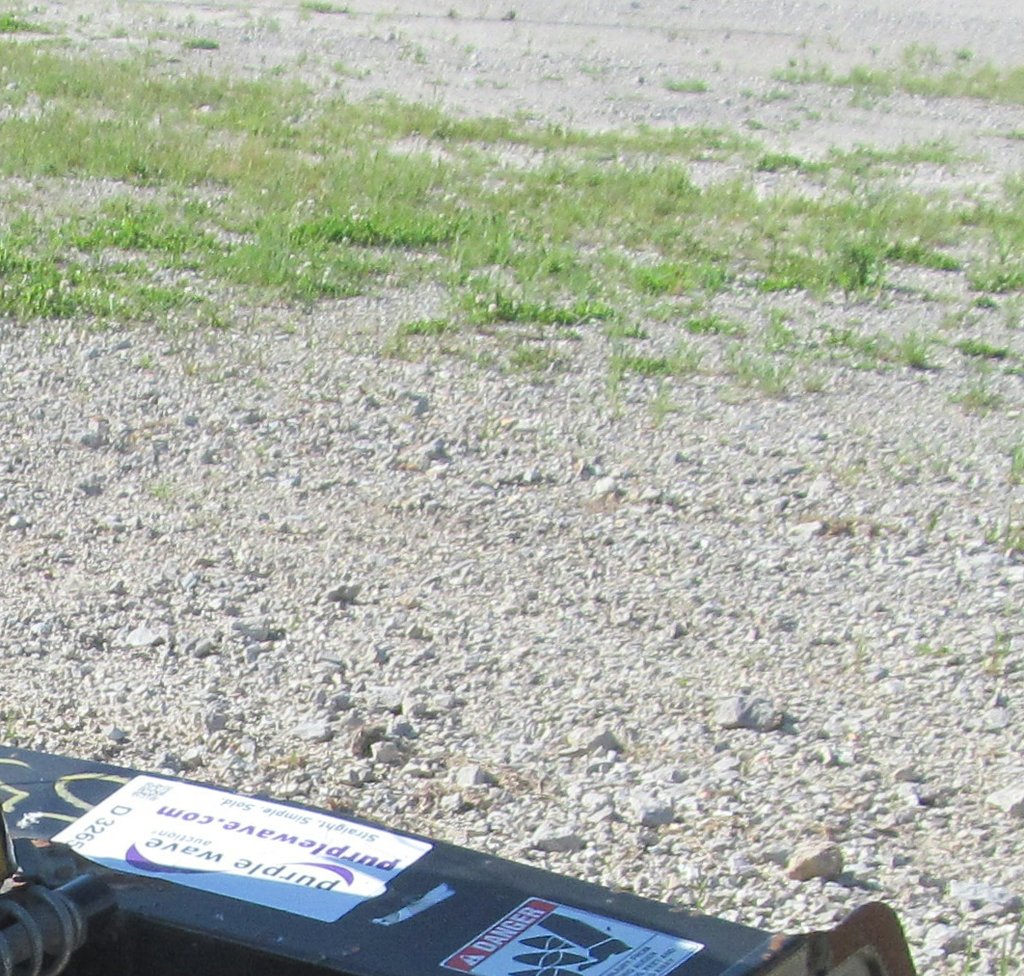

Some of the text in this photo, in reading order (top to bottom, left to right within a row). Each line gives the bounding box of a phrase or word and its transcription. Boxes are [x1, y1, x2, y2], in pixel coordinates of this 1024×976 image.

[110, 805, 132, 816] D
[318, 819, 380, 843] Straight.
[157, 806, 401, 871] purplewave.com
[145, 837, 340, 891] purple wave
[476, 907, 546, 951] DANGER
